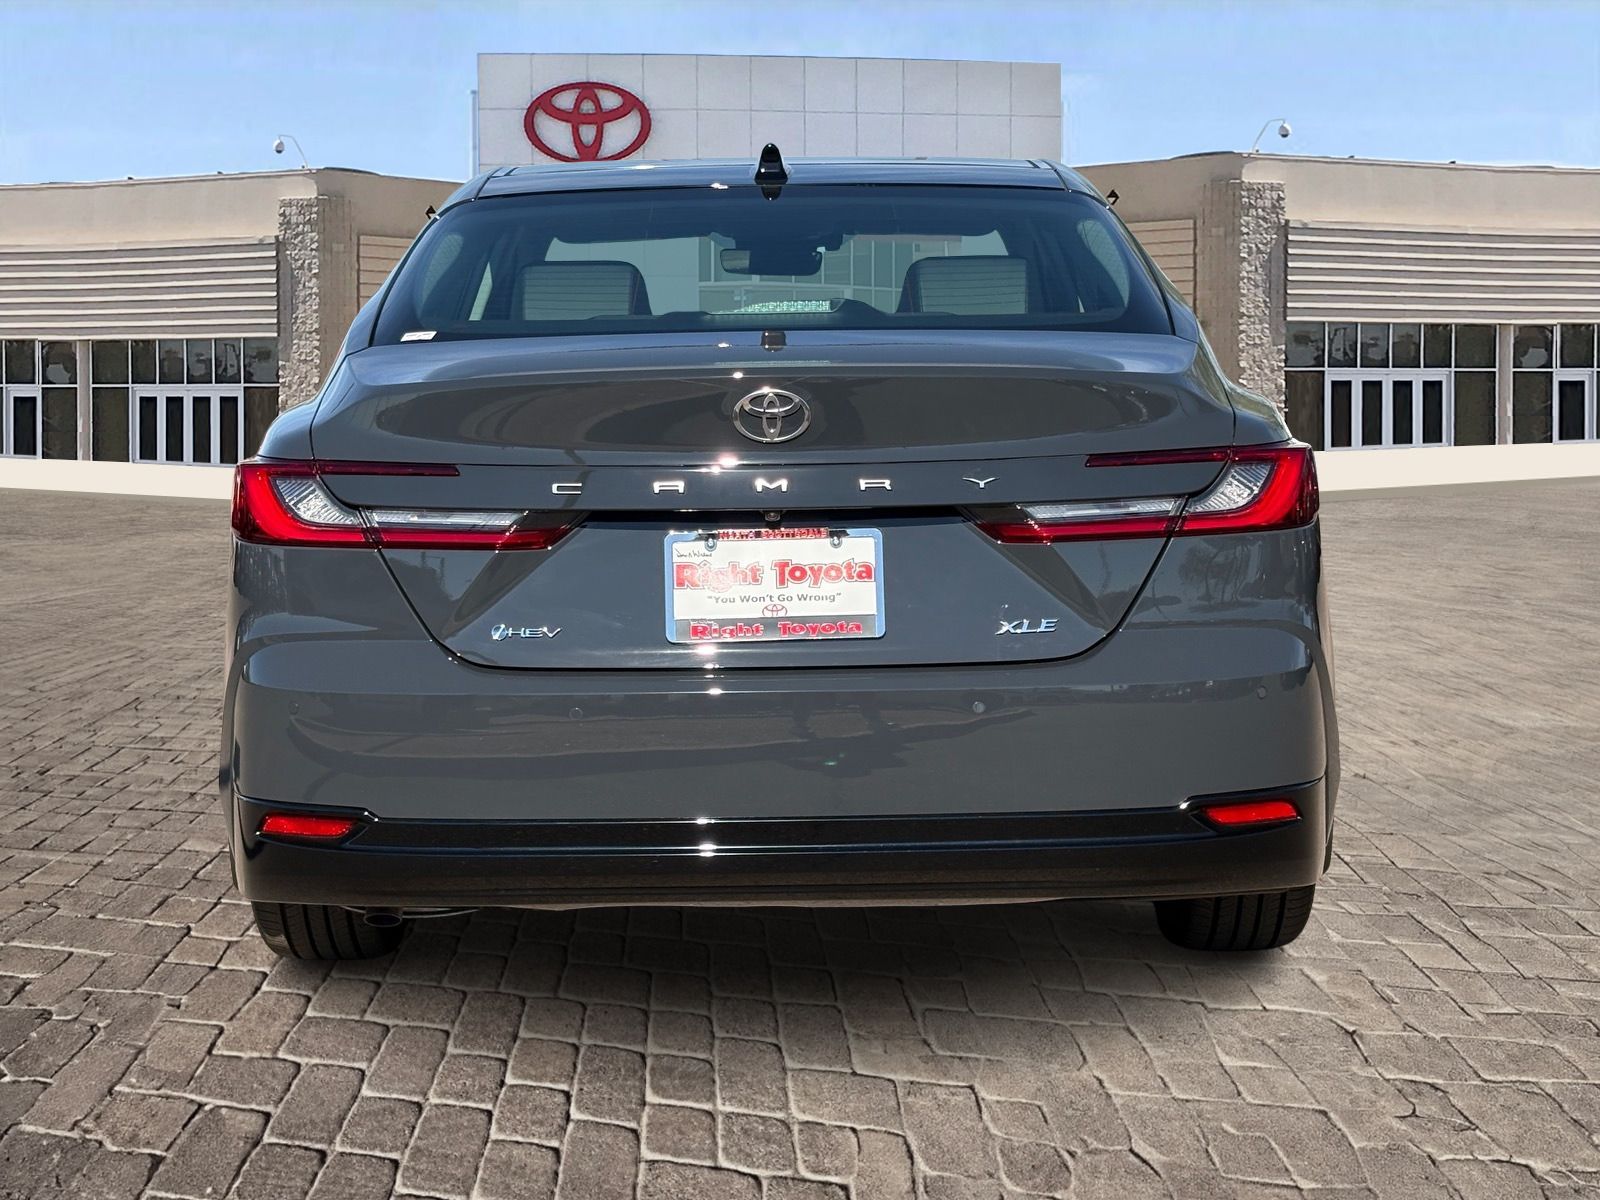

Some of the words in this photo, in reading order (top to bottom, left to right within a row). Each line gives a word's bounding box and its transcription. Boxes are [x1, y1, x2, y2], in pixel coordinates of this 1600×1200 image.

[551, 477, 999, 496] CAMRY
[674, 560, 764, 592] Right
[772, 558, 876, 589] Toyota
[740, 593, 774, 603] Won't
[777, 594, 793, 602] Go
[690, 622, 764, 640] Right
[778, 621, 863, 638] Toyota
[995, 618, 1059, 635] XLE
